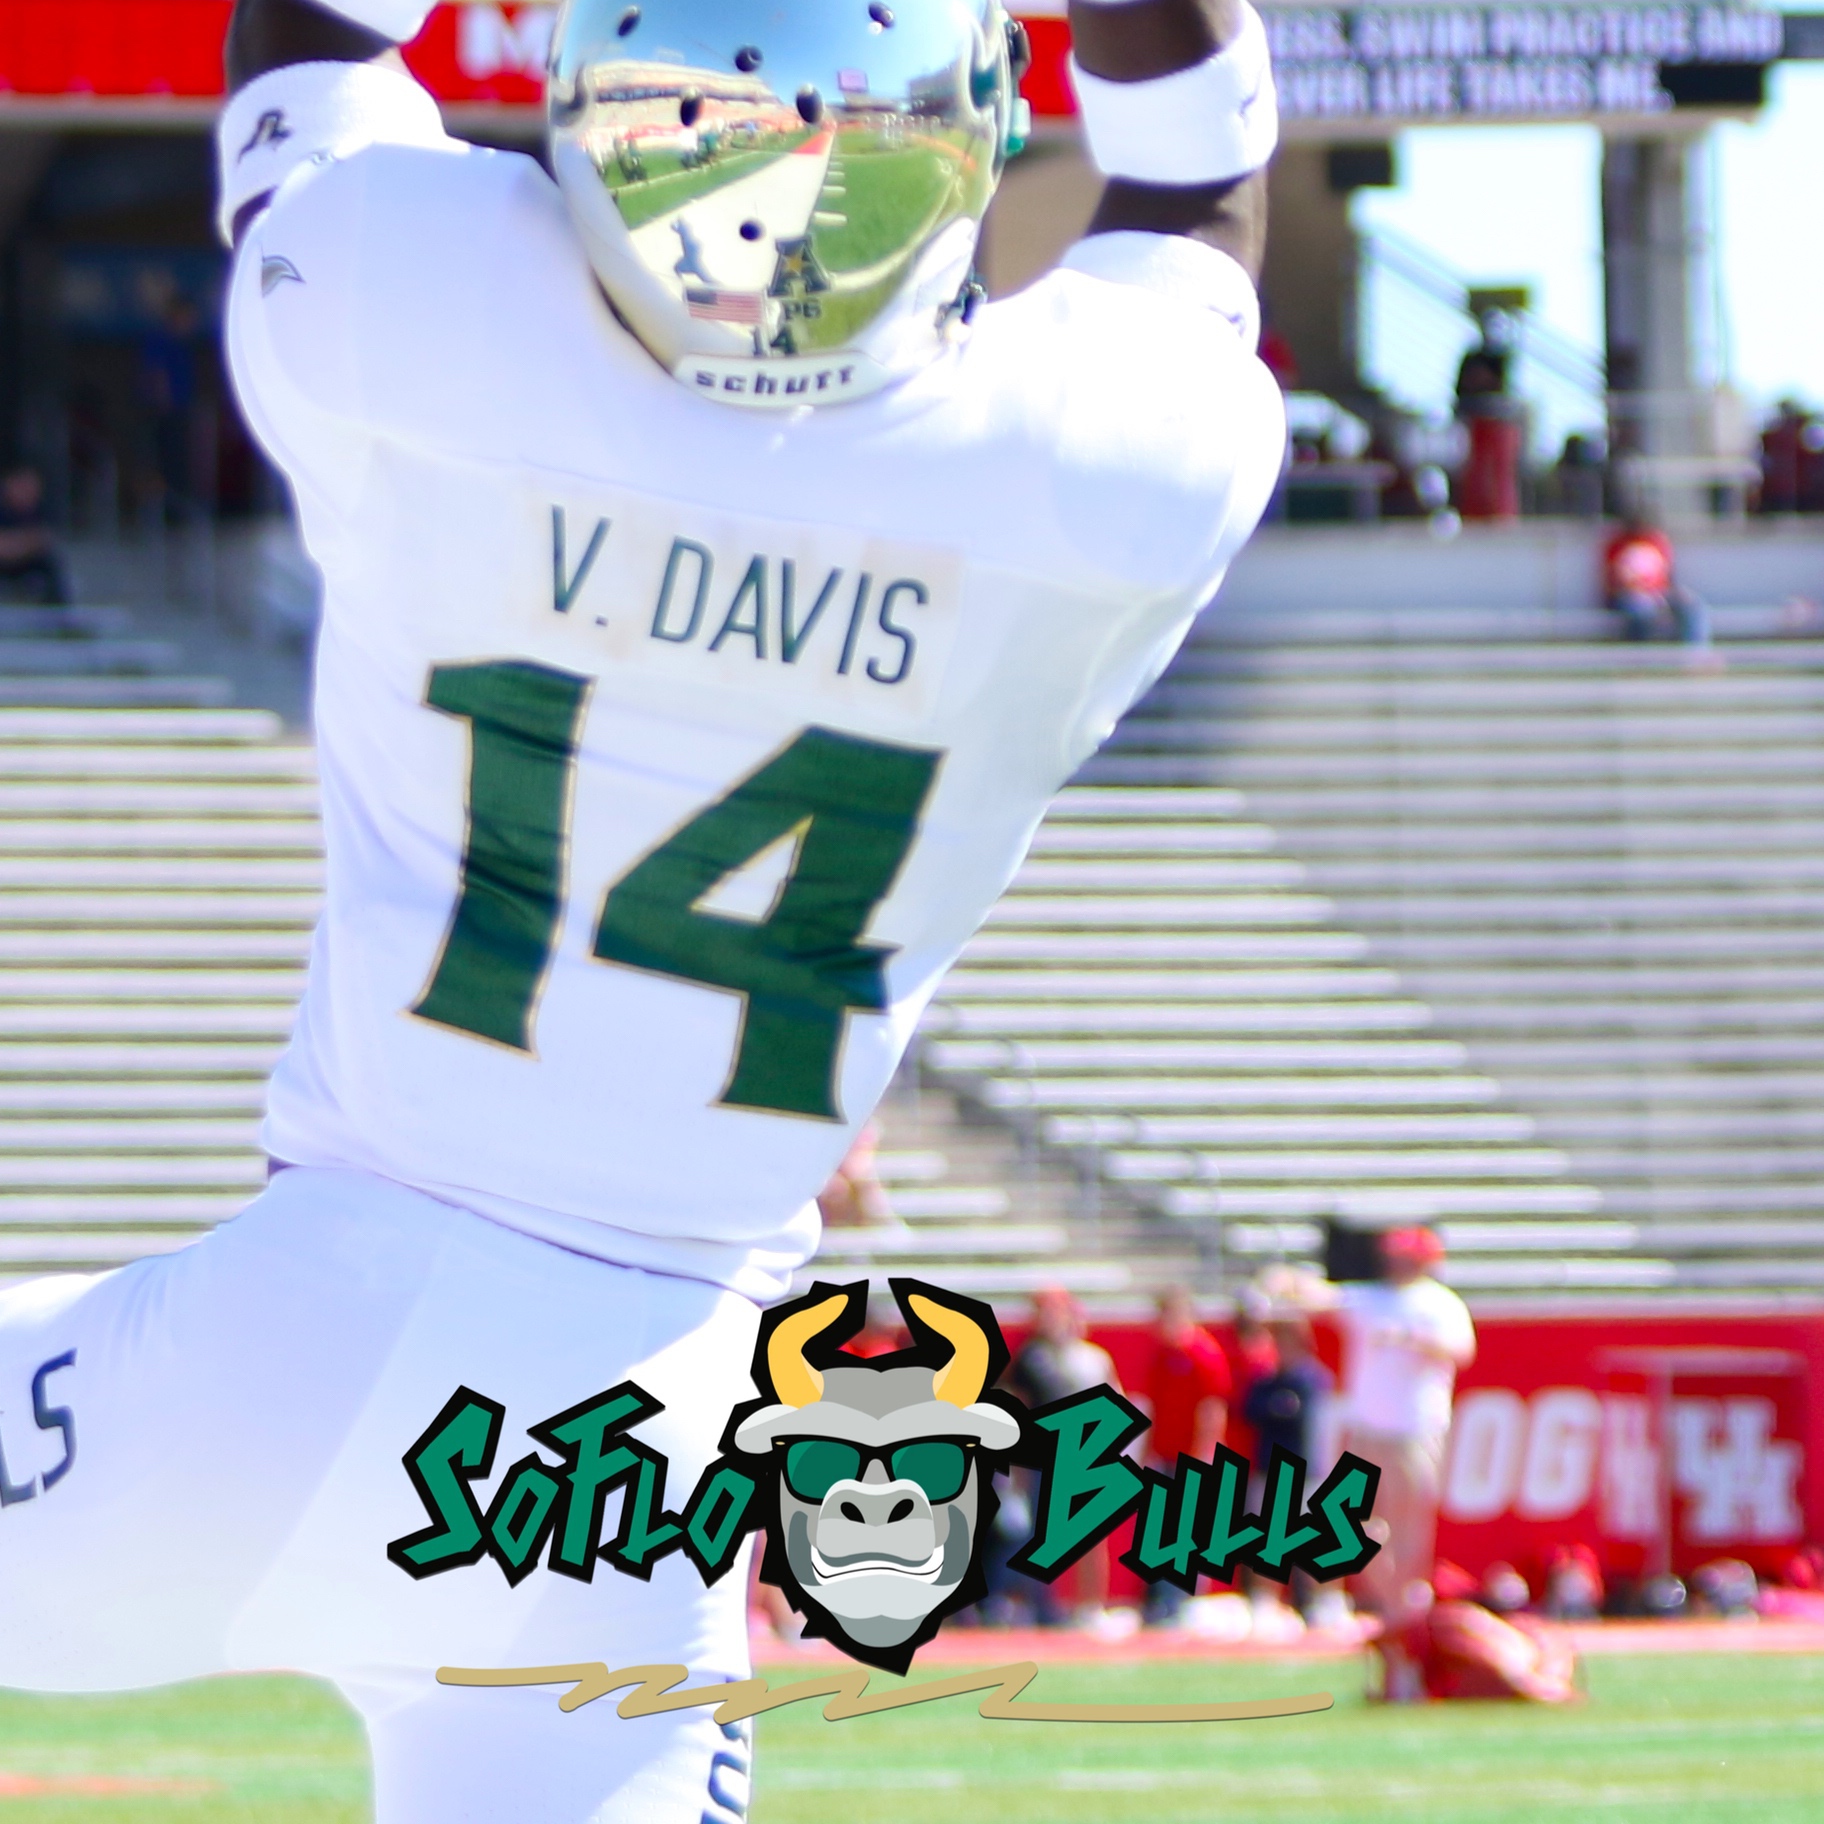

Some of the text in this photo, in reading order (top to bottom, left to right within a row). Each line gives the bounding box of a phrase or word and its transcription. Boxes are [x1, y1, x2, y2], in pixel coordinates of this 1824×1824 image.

[551, 503, 930, 685] V. DAVIS
[403, 657, 950, 1125] 14
